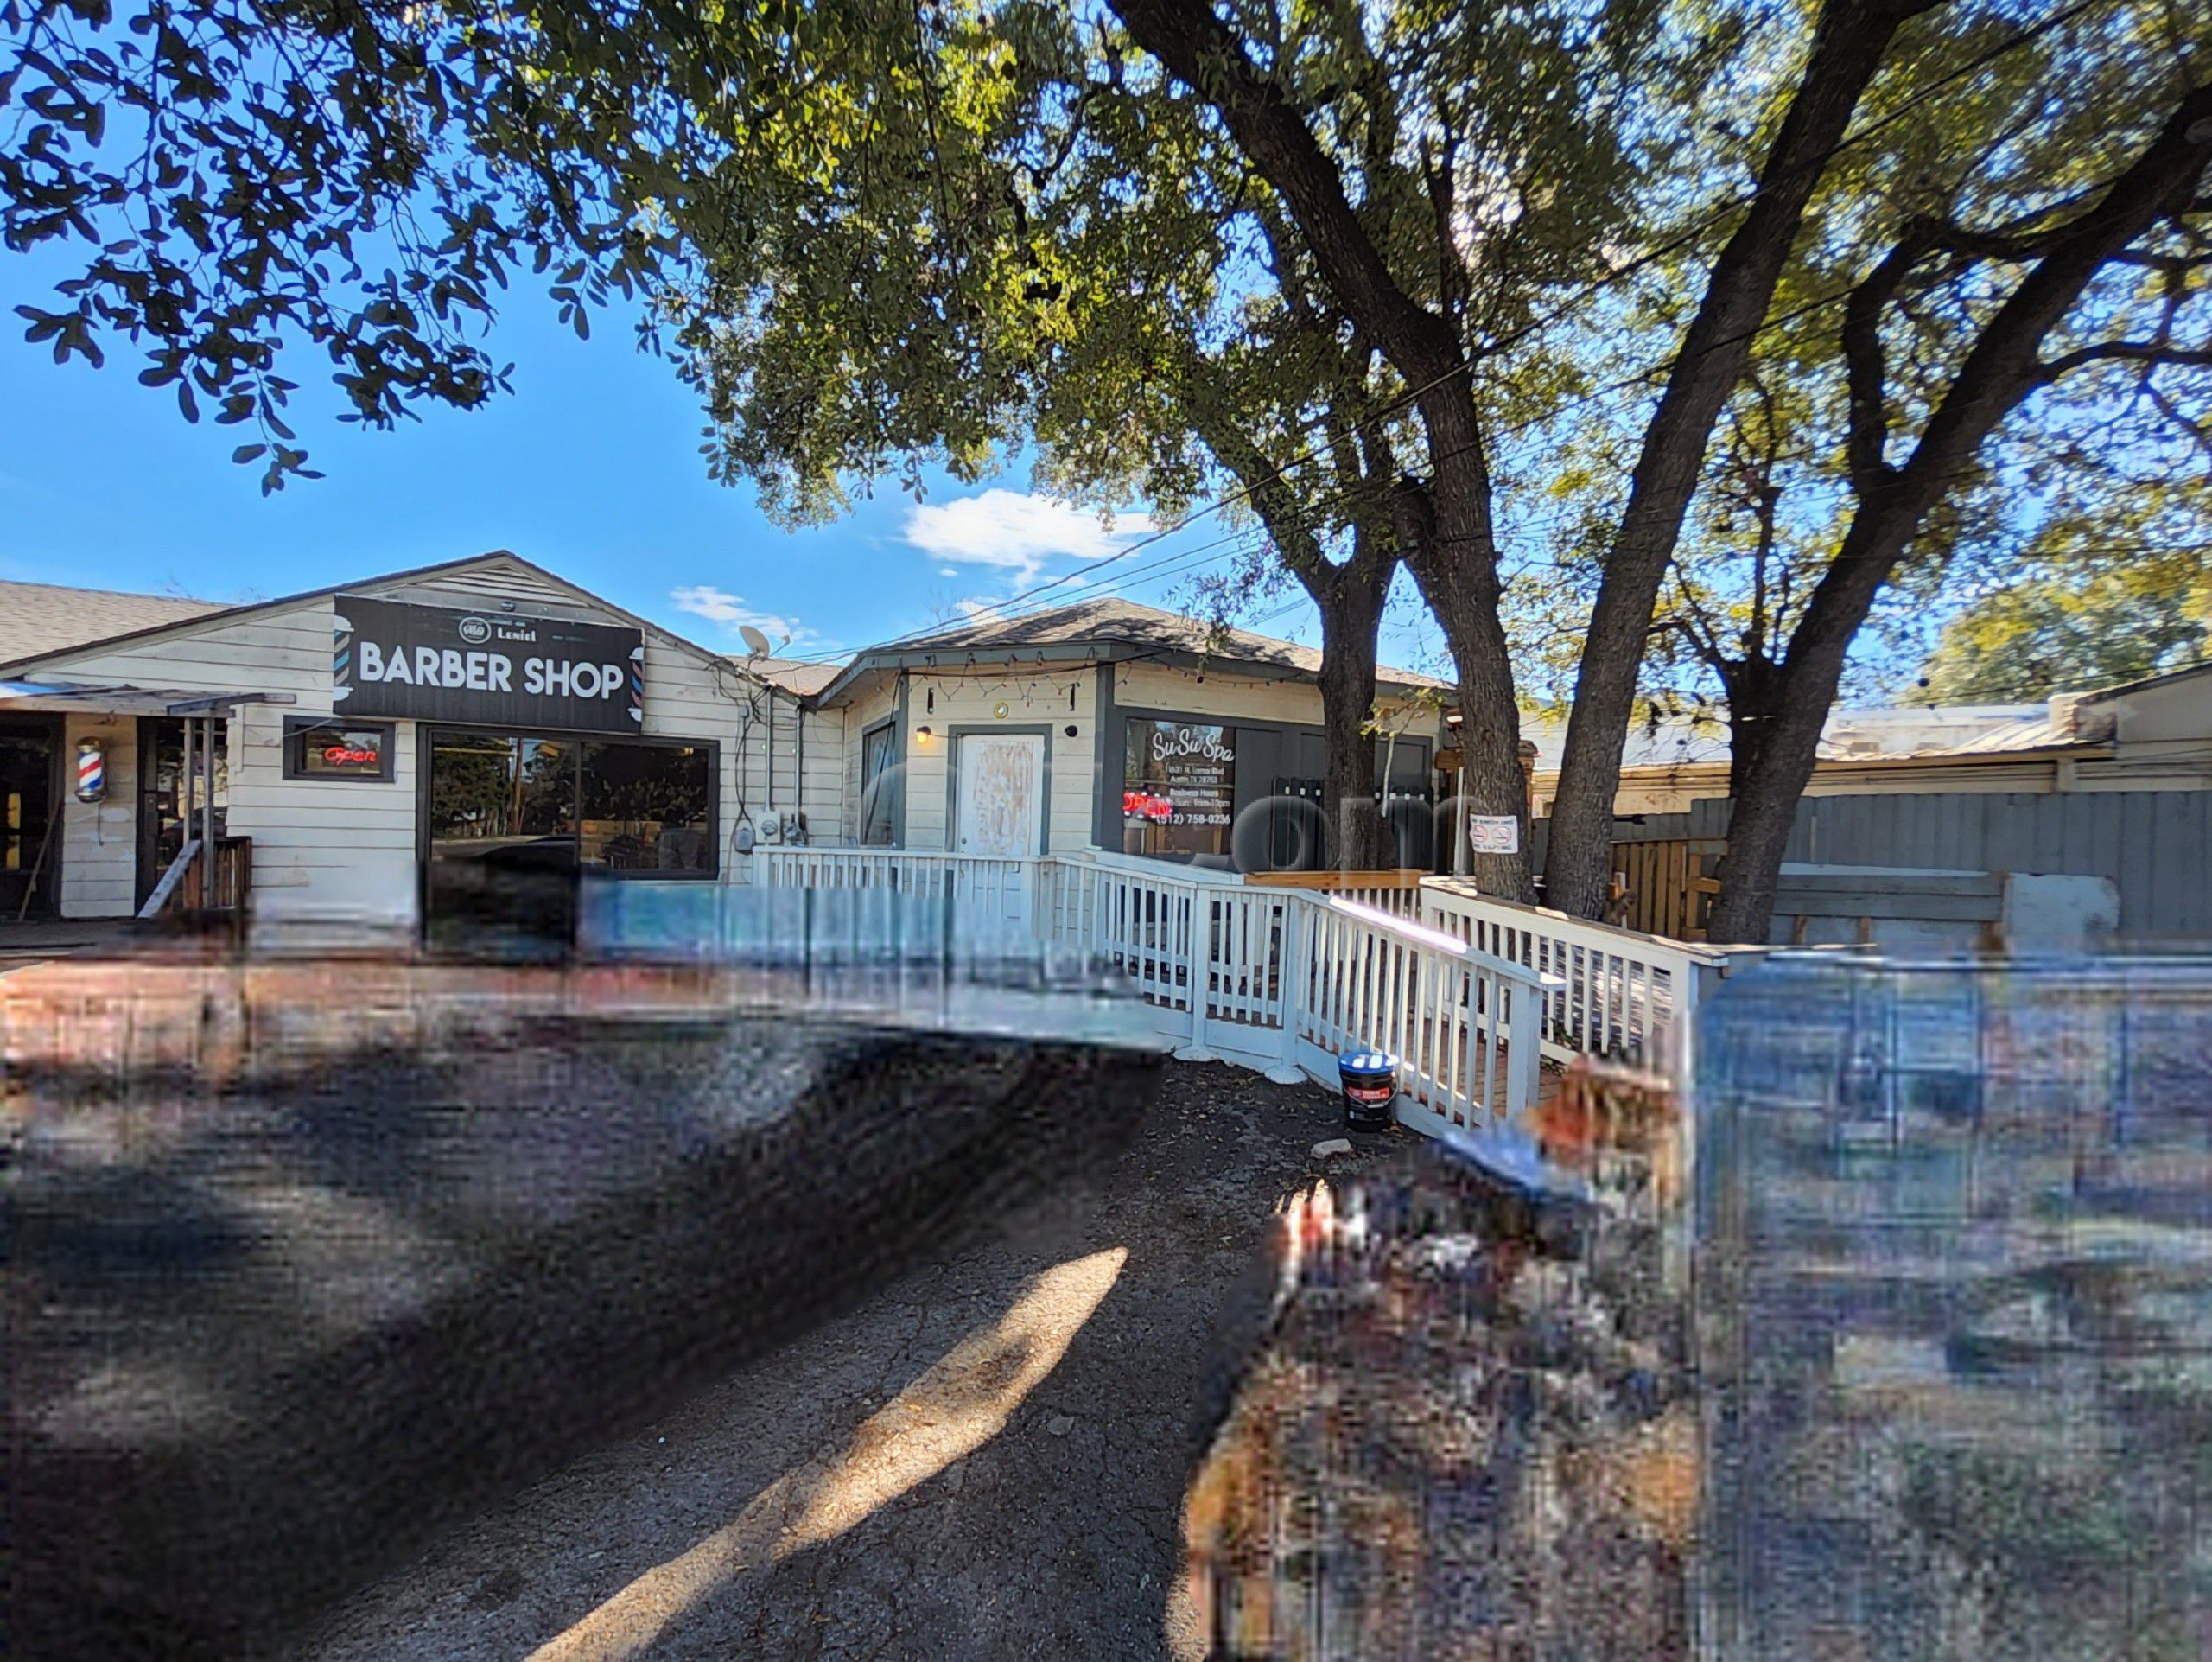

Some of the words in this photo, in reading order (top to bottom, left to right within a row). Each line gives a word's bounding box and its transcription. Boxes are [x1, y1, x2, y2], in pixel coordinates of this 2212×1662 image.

[359, 641, 512, 692] BARBER
[524, 657, 625, 700] SHOP
[325, 747, 378, 767] Open
[1202, 732, 1235, 762] Spa
[1122, 792, 1171, 815] OPEN
[1156, 814, 1185, 826] (512)
[1186, 814, 1231, 825] 758-0236
